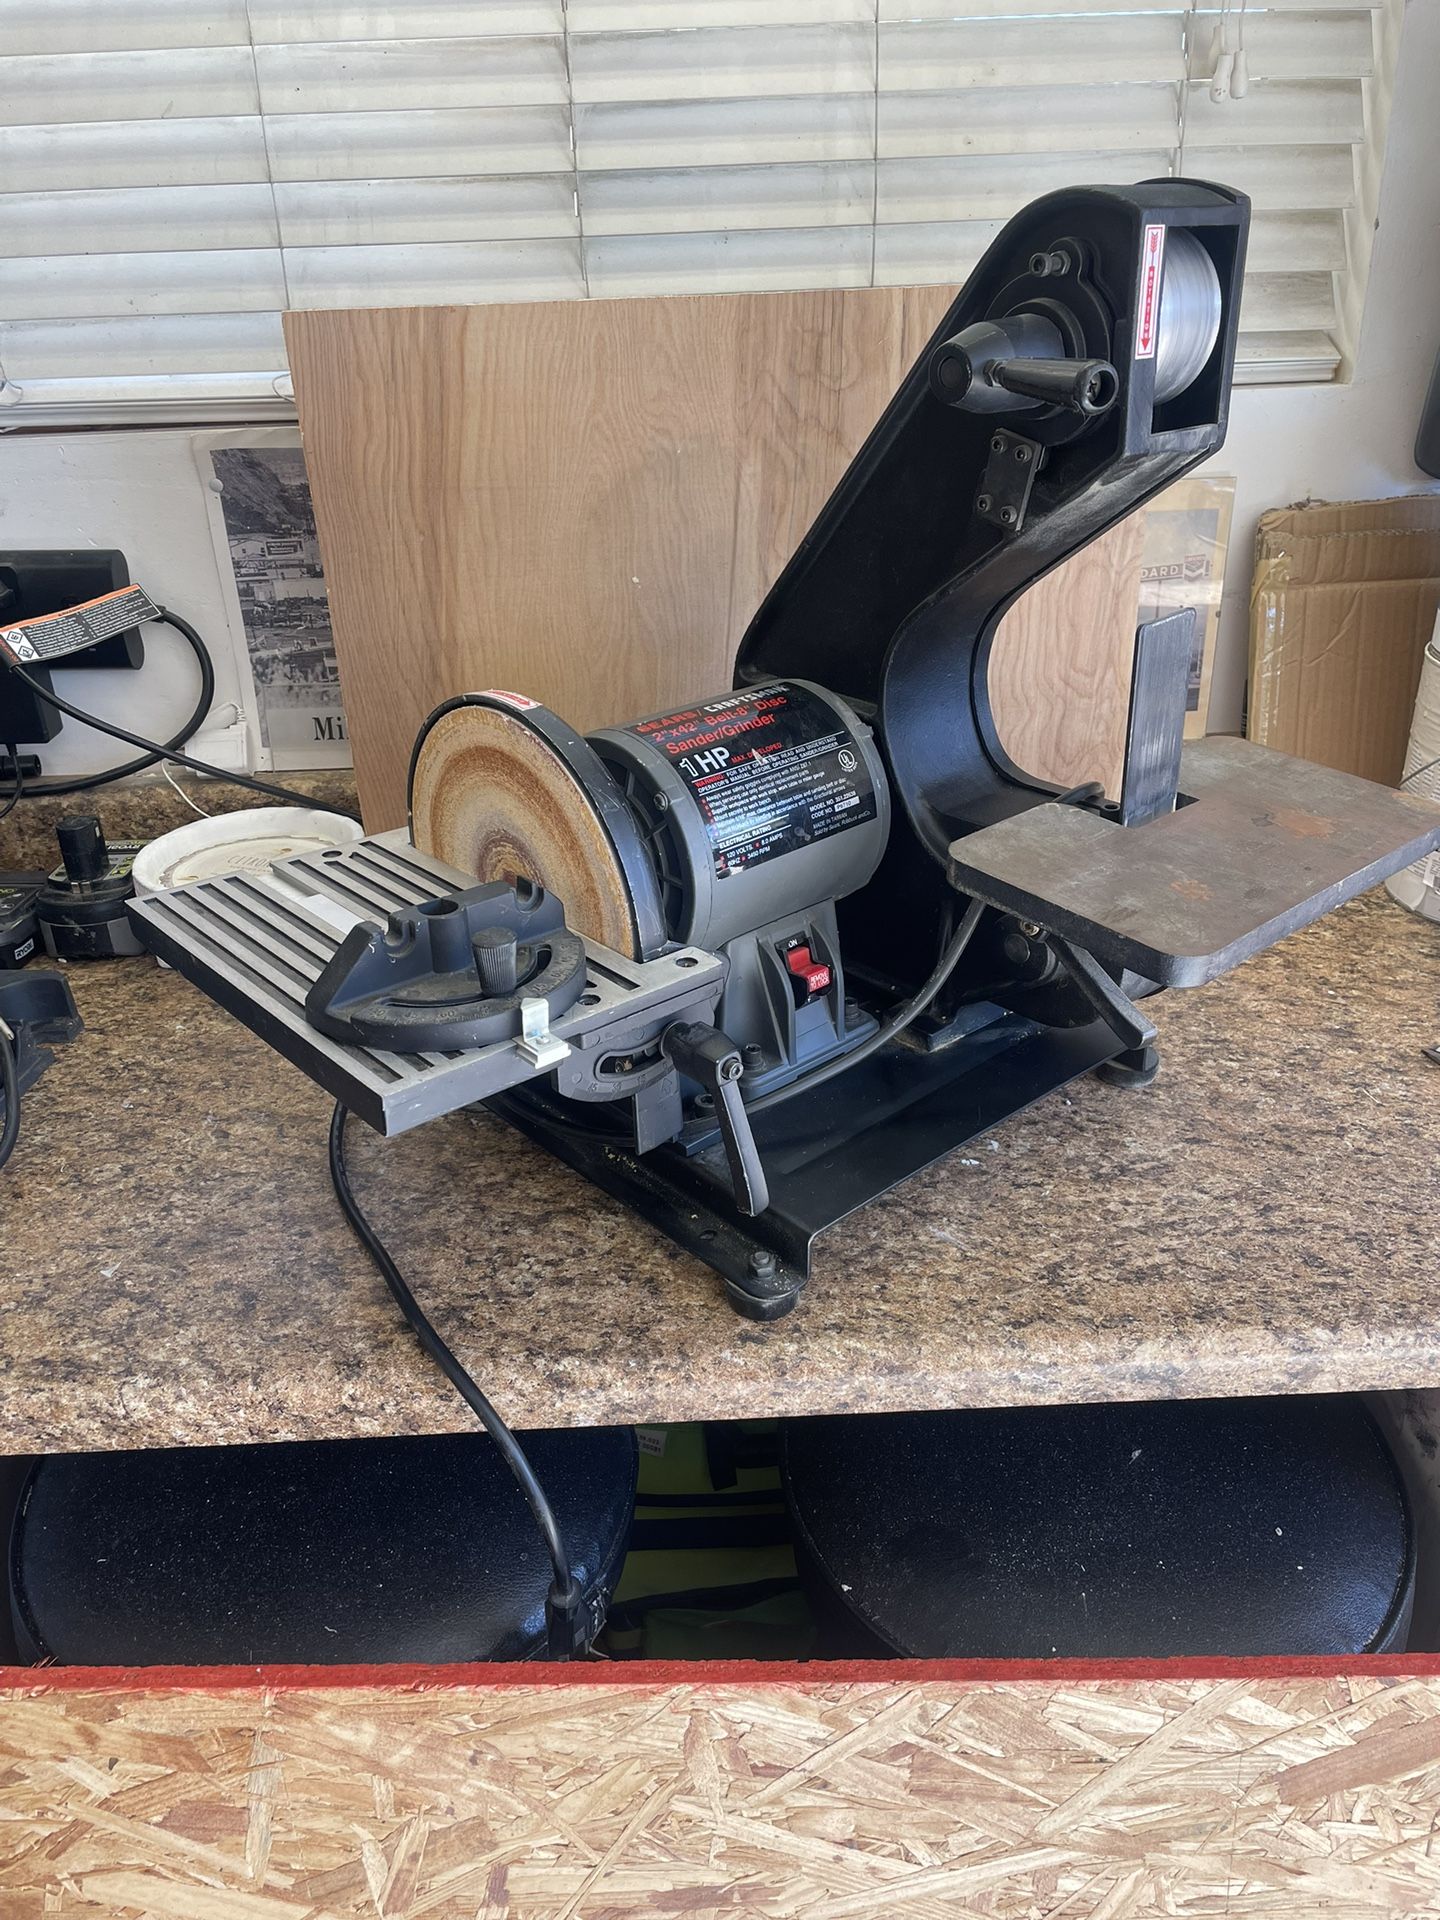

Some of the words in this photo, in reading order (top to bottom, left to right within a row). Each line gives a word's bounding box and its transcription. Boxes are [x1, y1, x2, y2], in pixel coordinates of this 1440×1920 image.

[754, 696, 788, 711] Disc
[666, 713, 776, 755] Sander/Grinder
[748, 743, 781, 757] DELOPED
[679, 756, 699, 778] 1
[693, 746, 730, 773] HP
[738, 765, 751, 773] SAFE
[729, 772, 750, 782] MANUAL
[751, 764, 771, 774] BEFORE
[788, 939, 798, 948] ON
